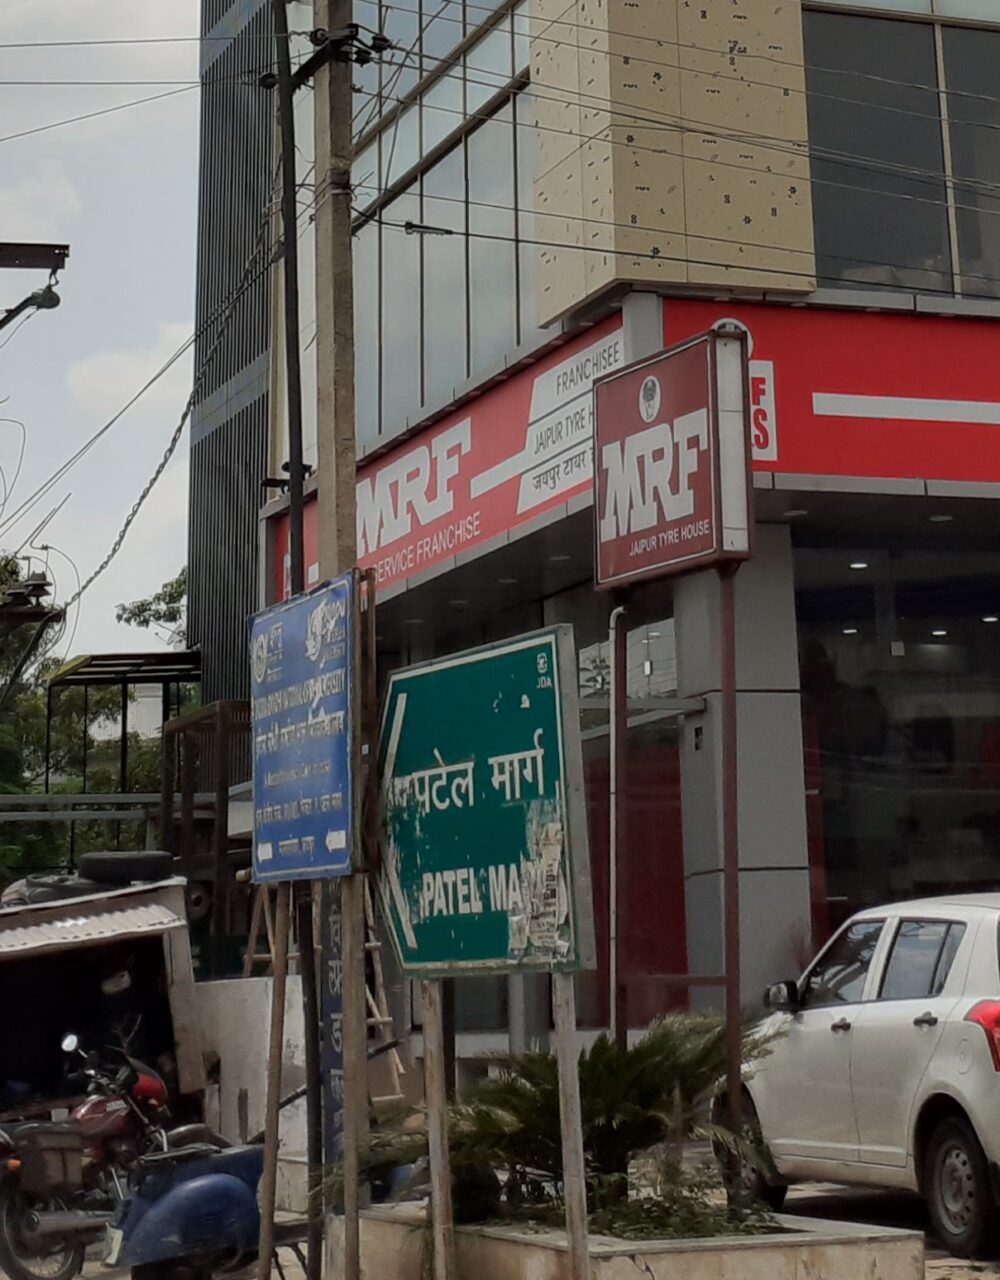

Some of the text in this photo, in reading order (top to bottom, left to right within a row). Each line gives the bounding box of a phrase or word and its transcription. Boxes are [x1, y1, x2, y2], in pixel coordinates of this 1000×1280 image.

[556, 340, 620, 396] FRANCHISEE
[533, 421, 563, 456] JAIPUR
[564, 407, 587, 437] TYRE
[357, 416, 472, 560] MRF
[563, 450, 587, 476] टायर
[600, 407, 709, 543] MRF
[416, 510, 482, 568] FRANCHISE
[628, 519, 711, 558] JAIPUR TYRE HOUSE
[535, 675, 553, 690] JDA
[413, 747, 475, 814] पटेल
[487, 726, 545, 802] मार्ग
[422, 866, 484, 919] PATEL
